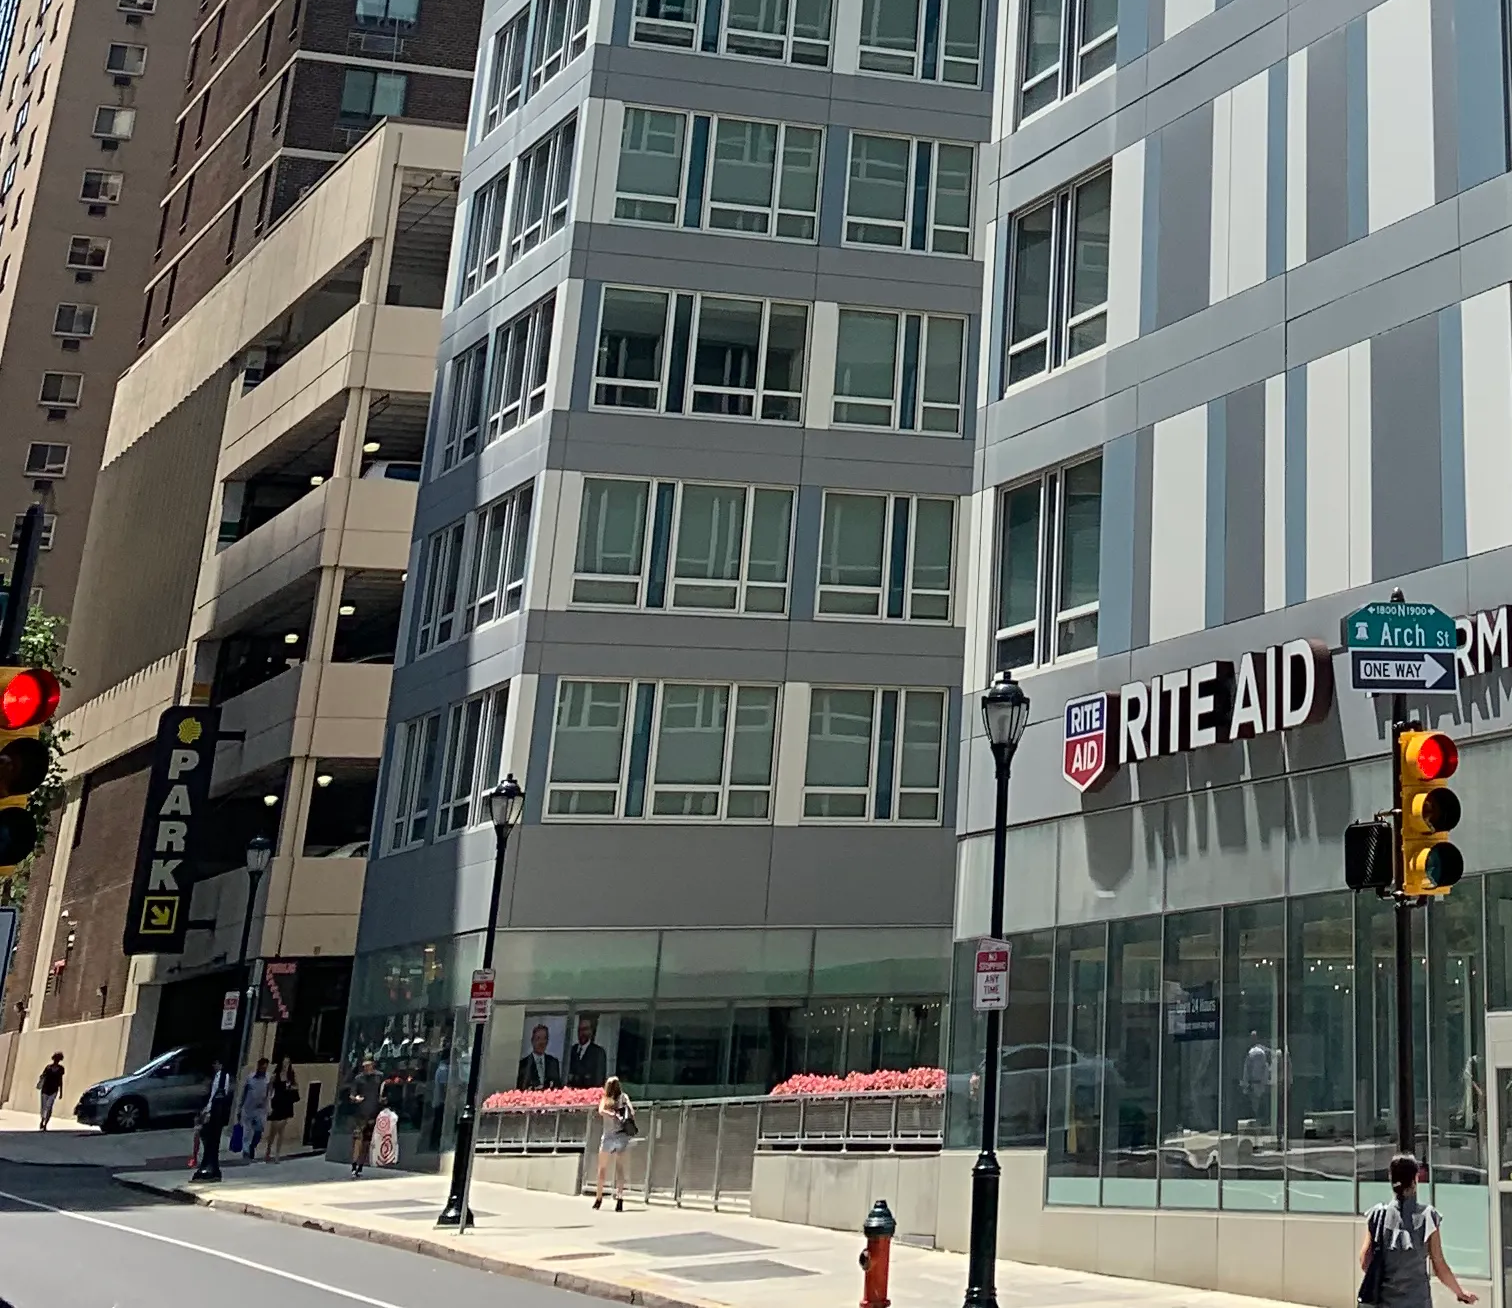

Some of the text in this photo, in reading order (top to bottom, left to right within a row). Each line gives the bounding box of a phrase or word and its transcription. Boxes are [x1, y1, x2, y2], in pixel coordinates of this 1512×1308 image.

[1376, 604, 1428, 617] 1800 N 1900
[1380, 622, 1450, 647] Arch St
[1363, 662, 1422, 678] ONE WAY
[1119, 637, 1316, 765] RITE AID
[1070, 701, 1101, 734] RITE
[1071, 739, 1099, 774] AID
[148, 749, 200, 891] PARK
[983, 985, 1000, 995] TIME
[984, 974, 1000, 984] ANY
